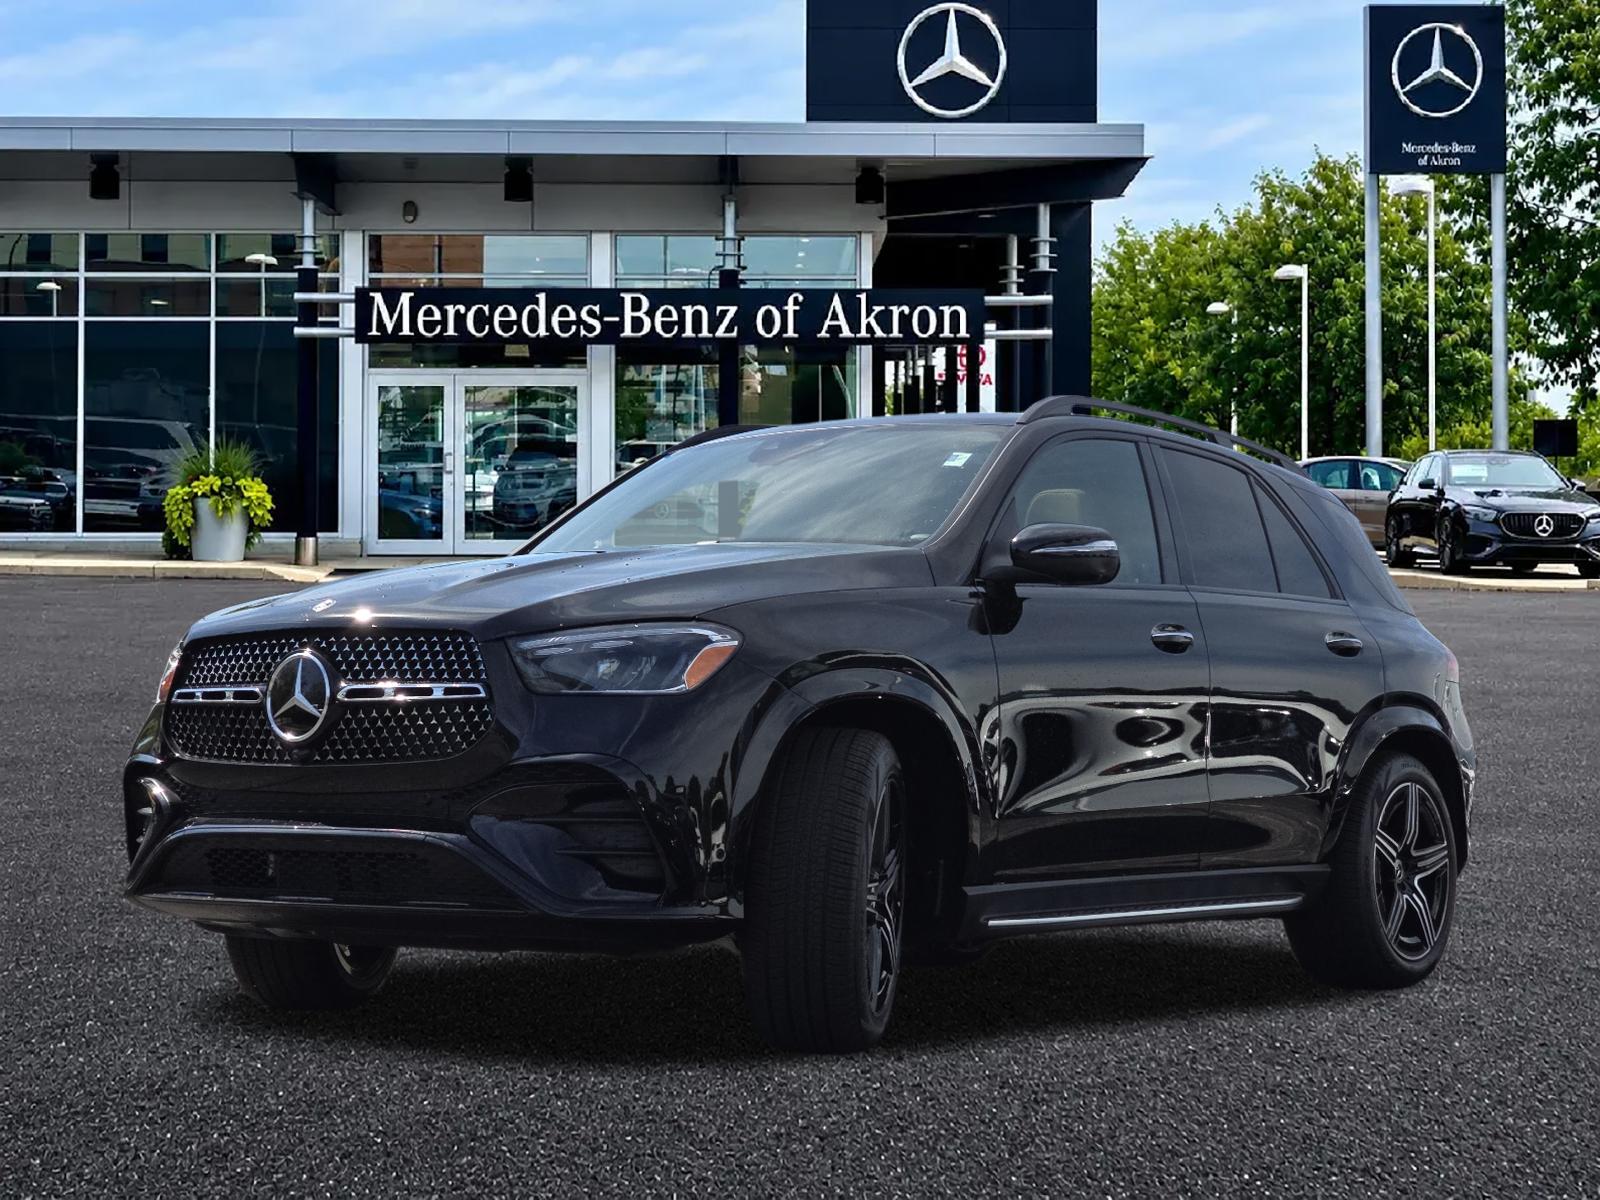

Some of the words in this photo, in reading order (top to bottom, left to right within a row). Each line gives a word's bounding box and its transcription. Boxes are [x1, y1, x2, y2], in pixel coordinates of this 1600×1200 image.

[1401, 142, 1477, 154] Mercedes-Benz
[1417, 154, 1429, 166] of
[1430, 154, 1461, 166] Akron
[367, 291, 739, 338] Mercedes-Benz
[755, 292, 804, 338] of
[816, 292, 970, 338] Akron
